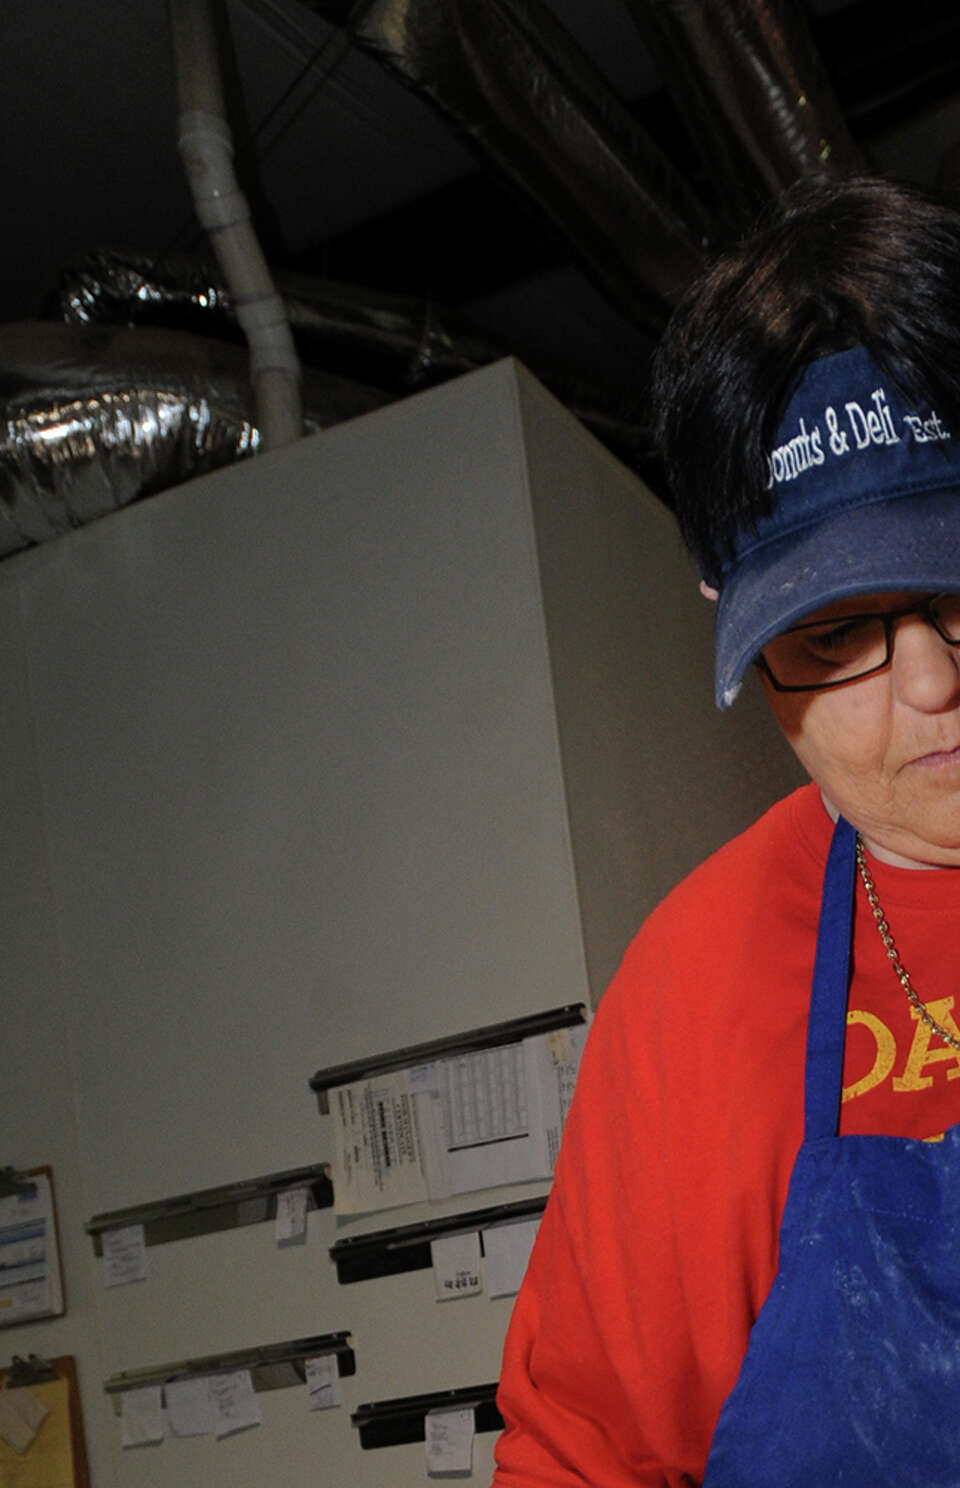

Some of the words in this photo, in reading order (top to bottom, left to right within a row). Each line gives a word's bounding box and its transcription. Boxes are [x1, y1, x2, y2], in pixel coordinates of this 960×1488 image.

[767, 417, 825, 489] onuts
[825, 406, 849, 456] &
[845, 388, 900, 450] Deli
[902, 410, 951, 443] Est.
